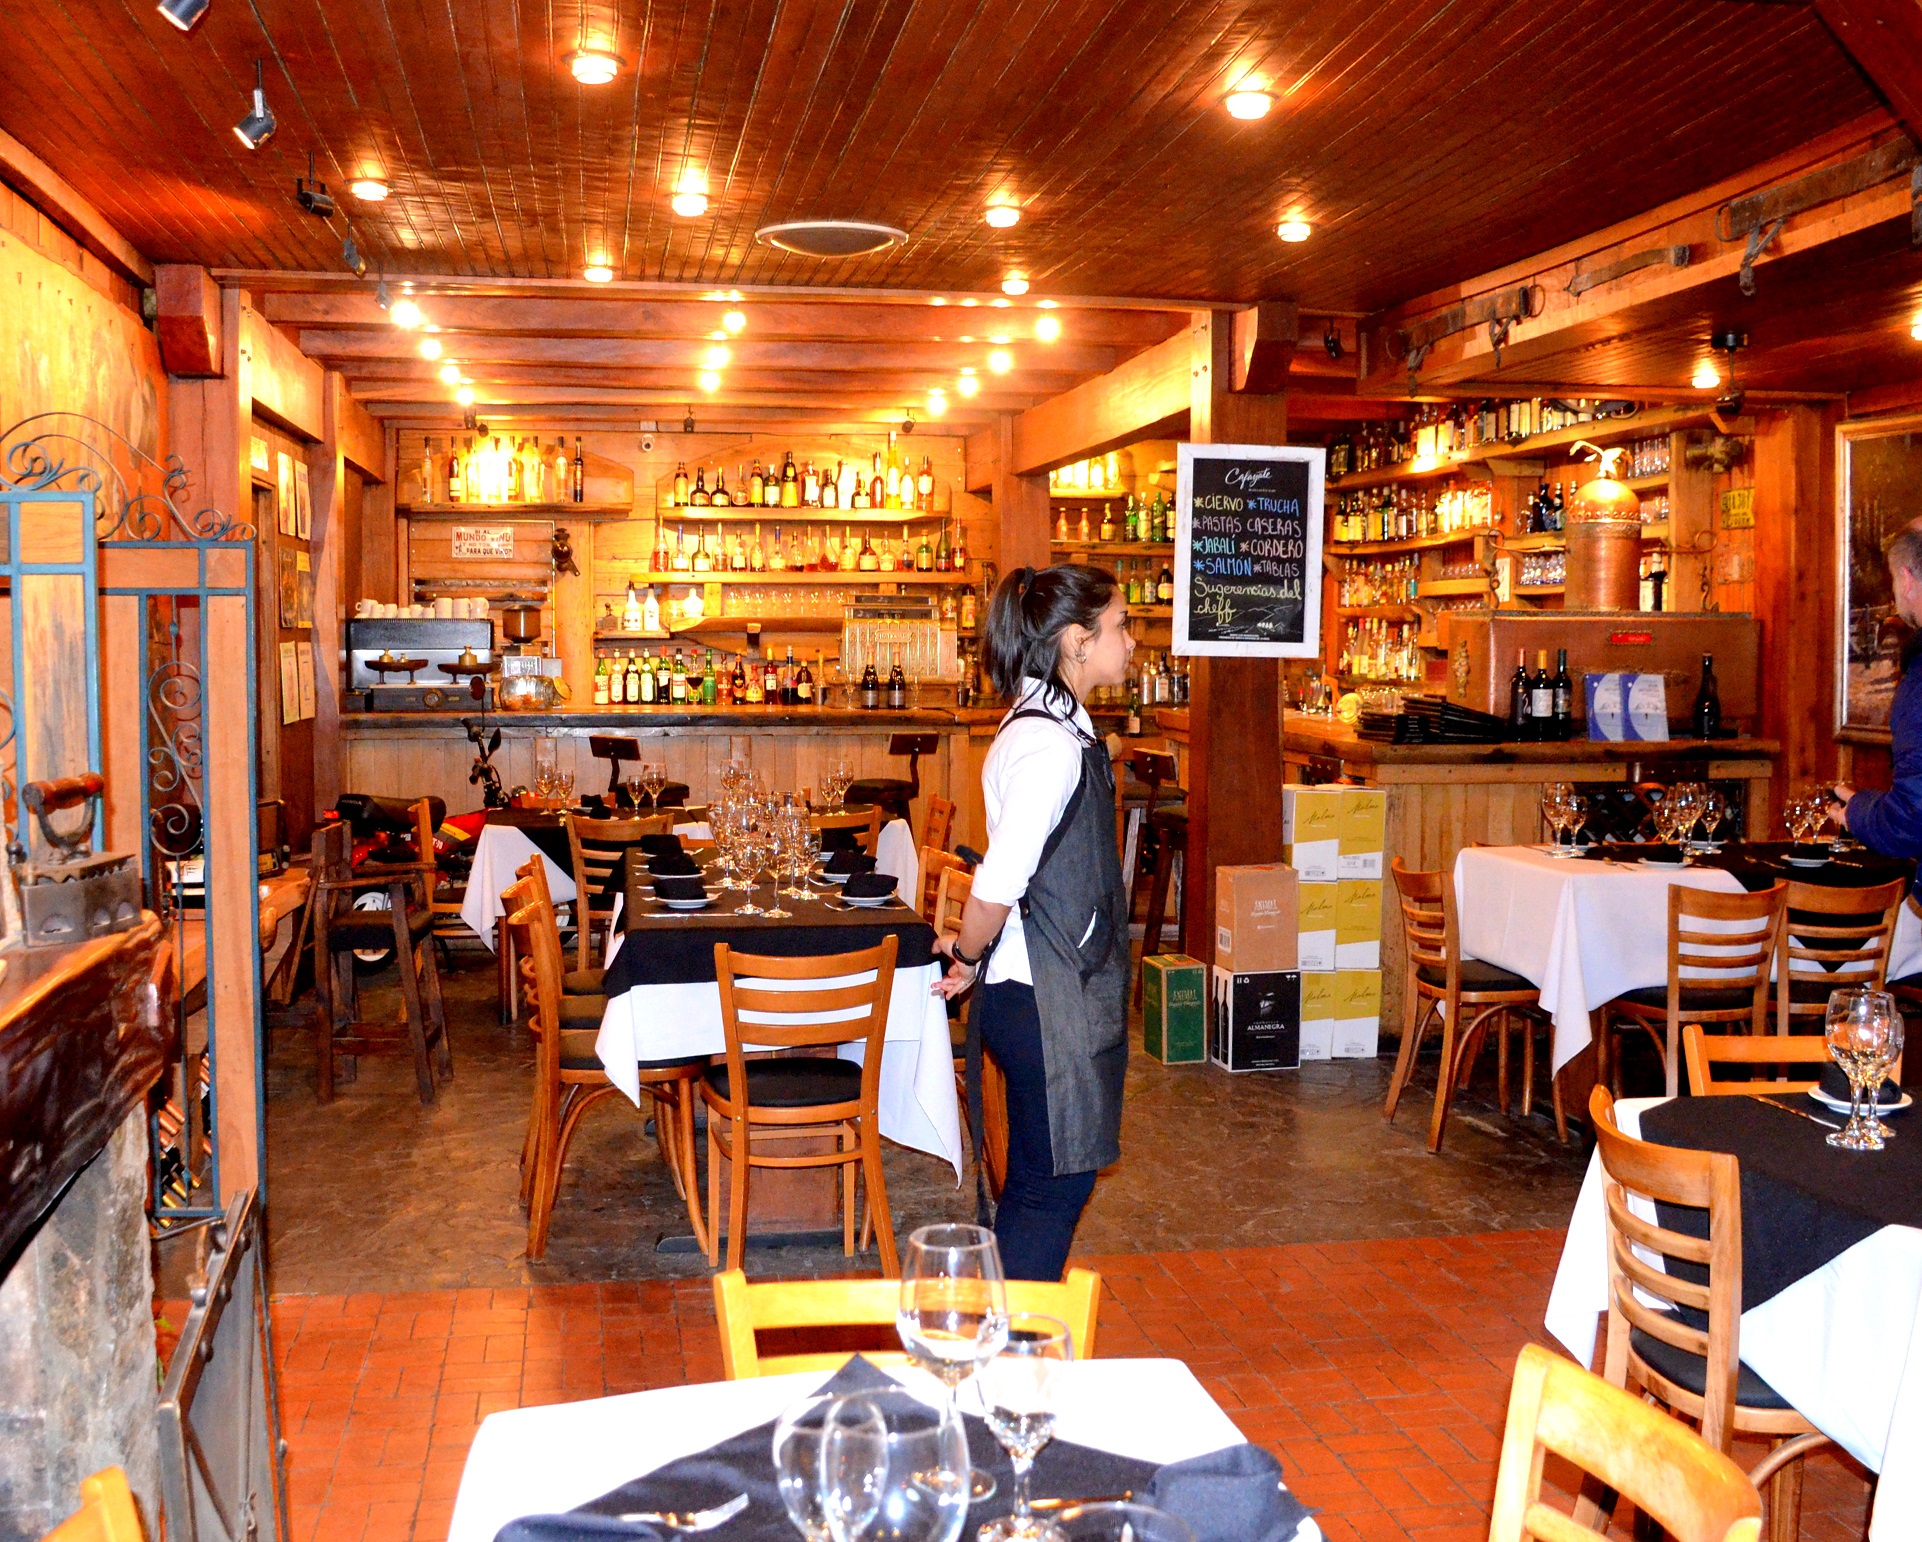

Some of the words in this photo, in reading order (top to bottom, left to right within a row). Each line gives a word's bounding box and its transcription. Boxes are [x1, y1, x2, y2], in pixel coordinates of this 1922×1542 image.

[1257, 496, 1299, 517] TRUCHA
[456, 532, 487, 541] MUNDO
[1202, 515, 1242, 533] PASTAS
[1247, 517, 1302, 538] CASERAS
[483, 548, 493, 556] QUE
[1251, 538, 1303, 558] CORDERO
[1206, 556, 1252, 576] SALMÓN
[1260, 560, 1300, 577] TABLAS
[1277, 578, 1302, 600] del
[1247, 1023, 1285, 1031] ALMANEGRA
